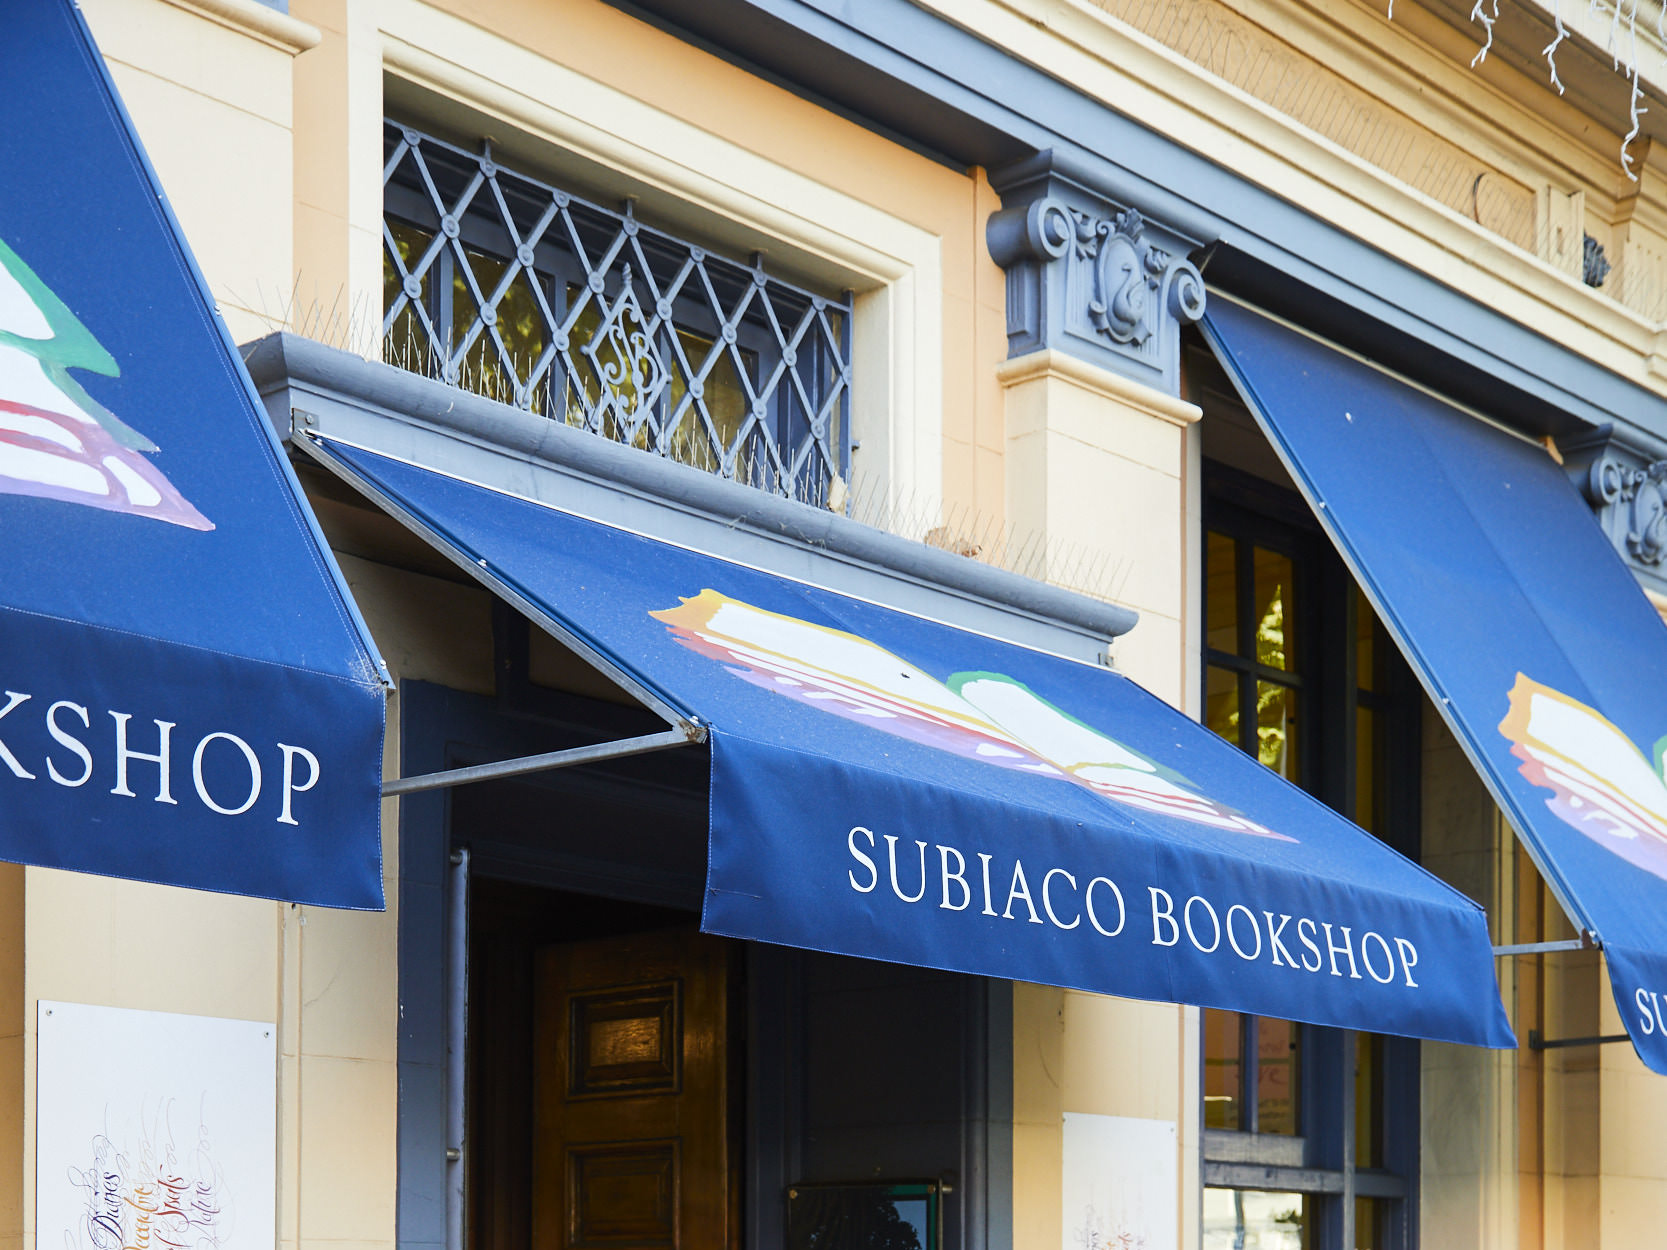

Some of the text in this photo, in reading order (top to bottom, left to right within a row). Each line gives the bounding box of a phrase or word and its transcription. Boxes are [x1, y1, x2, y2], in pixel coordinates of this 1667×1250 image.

[848, 827, 1419, 988] SUBIACO BOOKSHOP
[87, 1171, 125, 1248] Diaries
